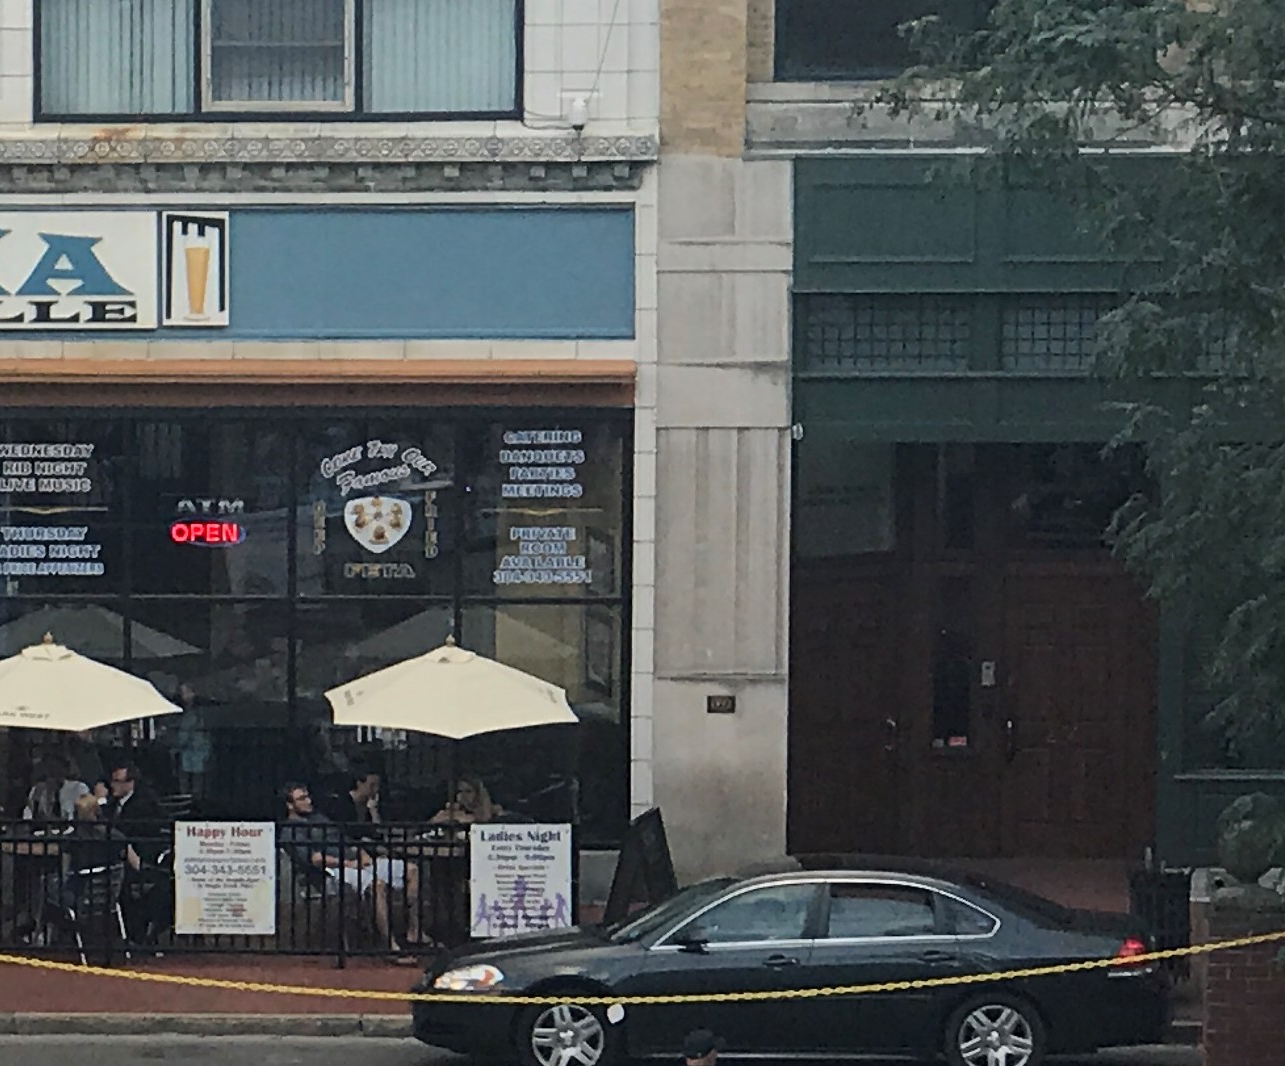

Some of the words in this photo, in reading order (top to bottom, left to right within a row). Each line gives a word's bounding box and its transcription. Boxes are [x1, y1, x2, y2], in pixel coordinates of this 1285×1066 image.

[503, 430, 582, 444] CATERING
[499, 450, 585, 464] BANQUETS
[2, 461, 32, 475] RIB
[34, 461, 88, 475] NIGHT
[509, 466, 576, 480] PARTIES
[38, 478, 92, 492] MUSIC
[502, 484, 583, 498] MEETINGS
[176, 498, 245, 514] ATM
[0, 526, 88, 541] THURSDAY
[171, 523, 238, 542] OPEN
[510, 527, 576, 541] PRIVATE
[48, 544, 102, 559] NIGHT
[519, 541, 567, 554] ROOM
[499, 555, 586, 569] AVAILABLE
[186, 825, 227, 838] Happy
[230, 826, 264, 838] Hour
[479, 829, 523, 842] Ladies
[527, 829, 562, 843] Night
